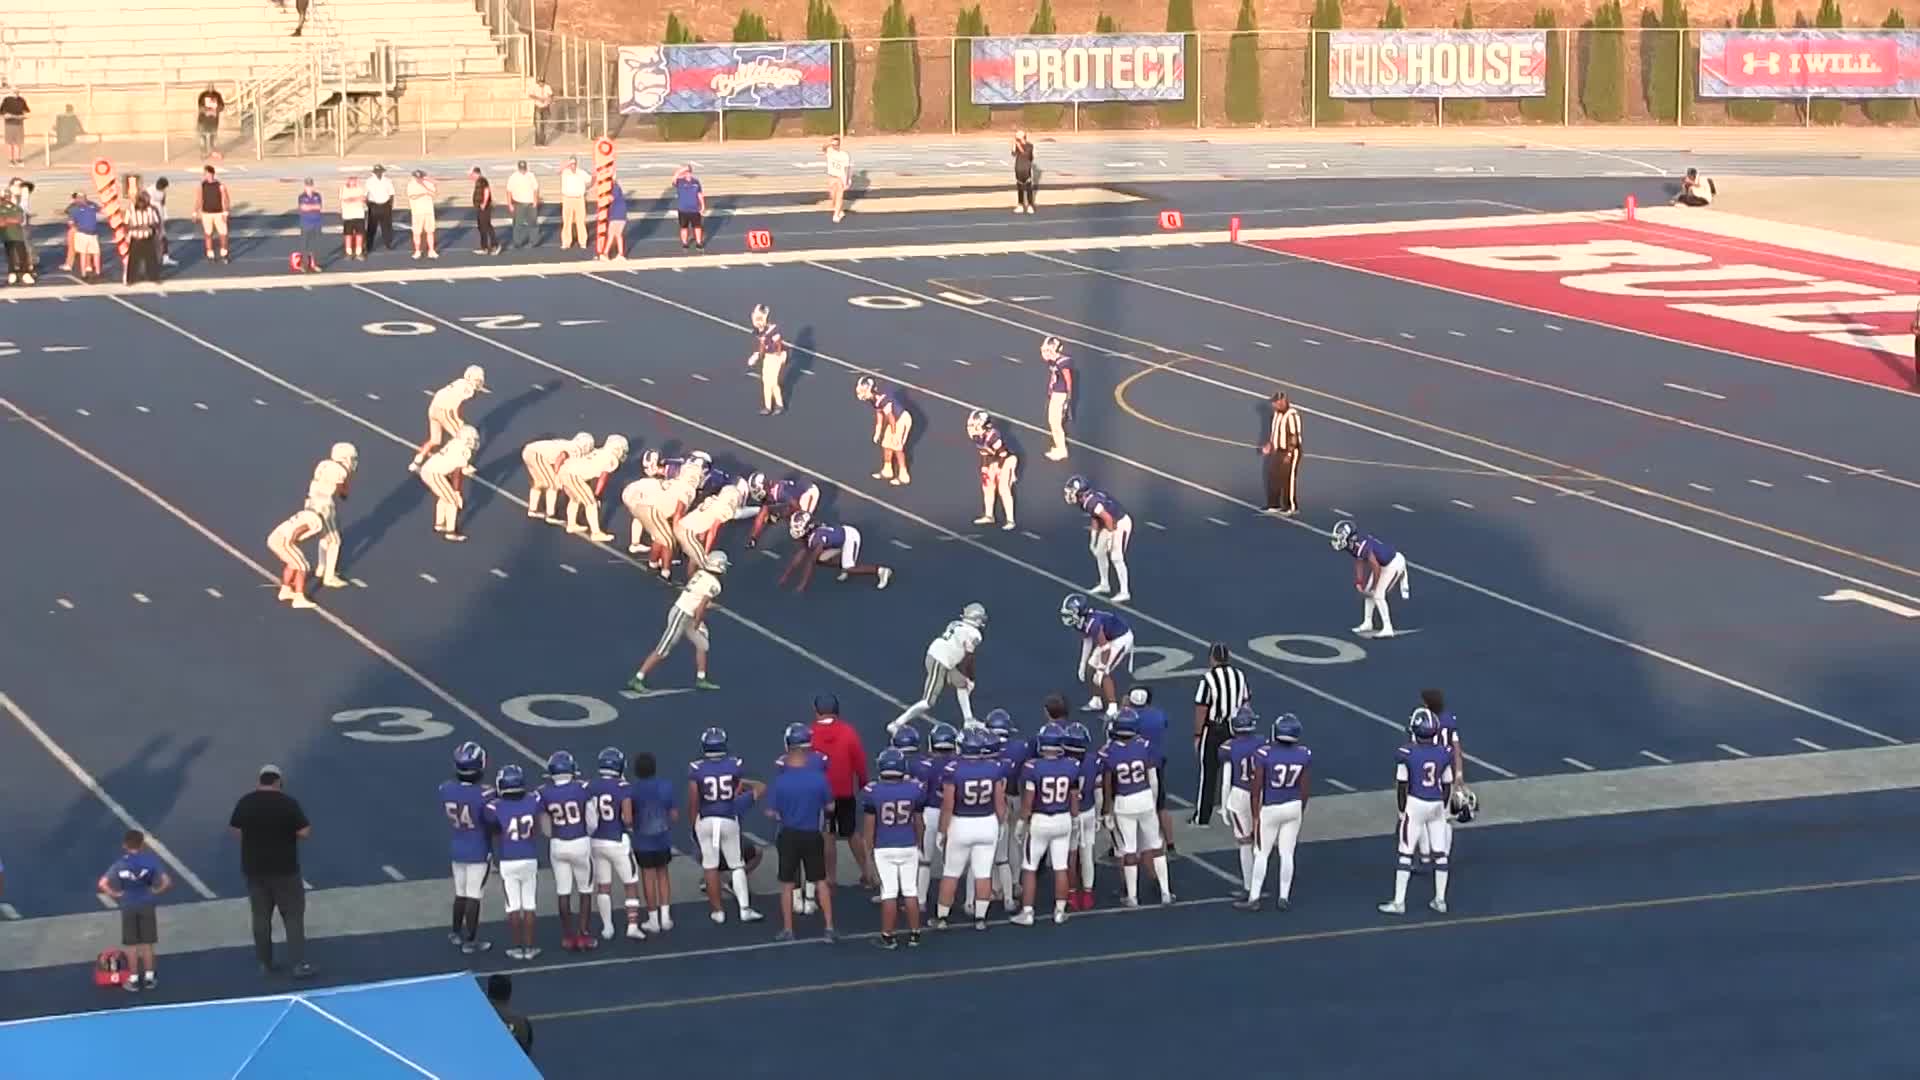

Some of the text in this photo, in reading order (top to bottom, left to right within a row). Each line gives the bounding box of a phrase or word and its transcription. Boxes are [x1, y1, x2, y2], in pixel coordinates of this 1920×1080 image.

[1015, 46, 1180, 91] PROTECT
[1335, 42, 1540, 86] THIS HOUSE.
[1789, 53, 1882, 73] I WILL.
[751, 232, 769, 248] 10
[1131, 634, 1367, 680] 20
[331, 694, 619, 742] 30
[1271, 764, 1303, 787] 37
[1421, 761, 1436, 787] 3
[703, 774, 733, 801] 35
[963, 780, 993, 805] 52
[1041, 776, 1069, 804] 58
[444, 801, 475, 829] 54
[548, 801, 580, 825] 20
[881, 800, 911, 825] 65
